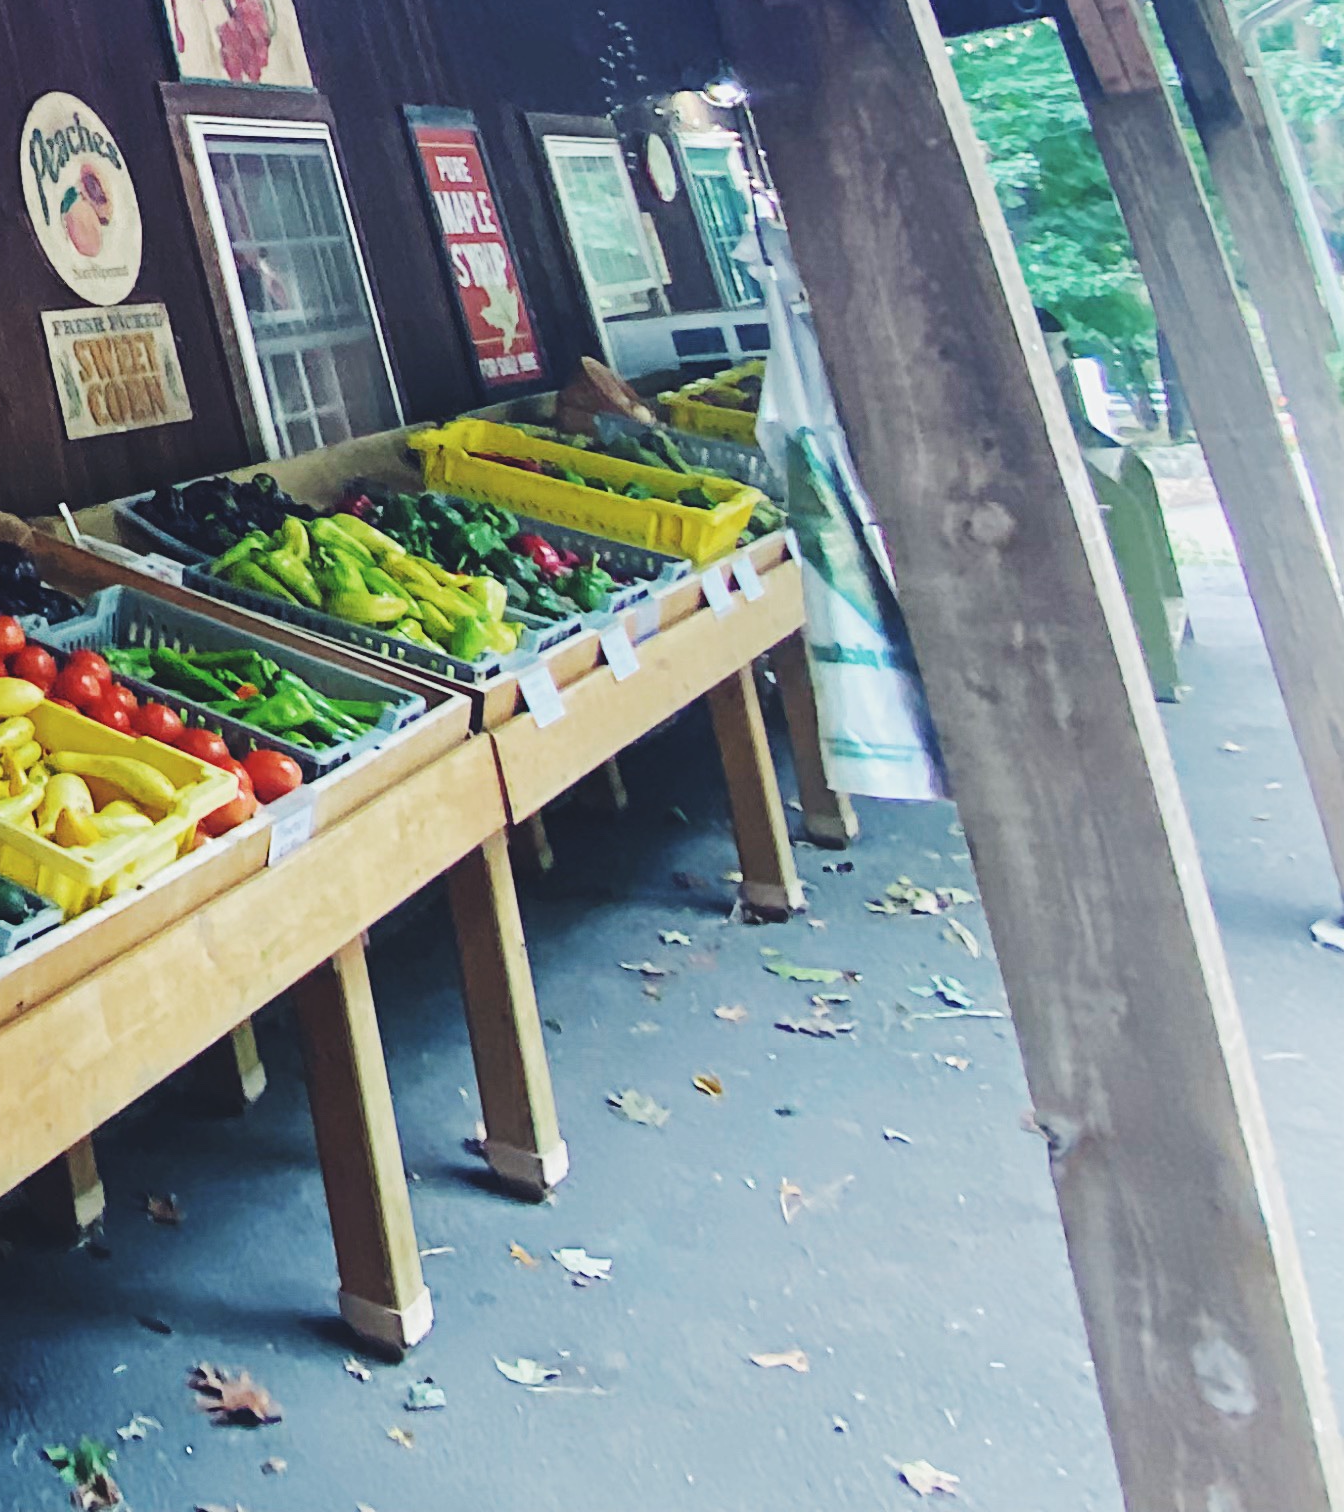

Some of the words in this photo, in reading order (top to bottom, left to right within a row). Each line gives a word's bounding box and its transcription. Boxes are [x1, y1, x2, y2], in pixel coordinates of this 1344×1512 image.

[29, 111, 122, 227] Peaches
[434, 155, 473, 183] PURE
[432, 191, 497, 234] MAPLE
[450, 241, 508, 288] SYRUP
[52, 316, 107, 337] FRESH
[72, 331, 158, 383] SWEET
[86, 375, 168, 427] CORN
